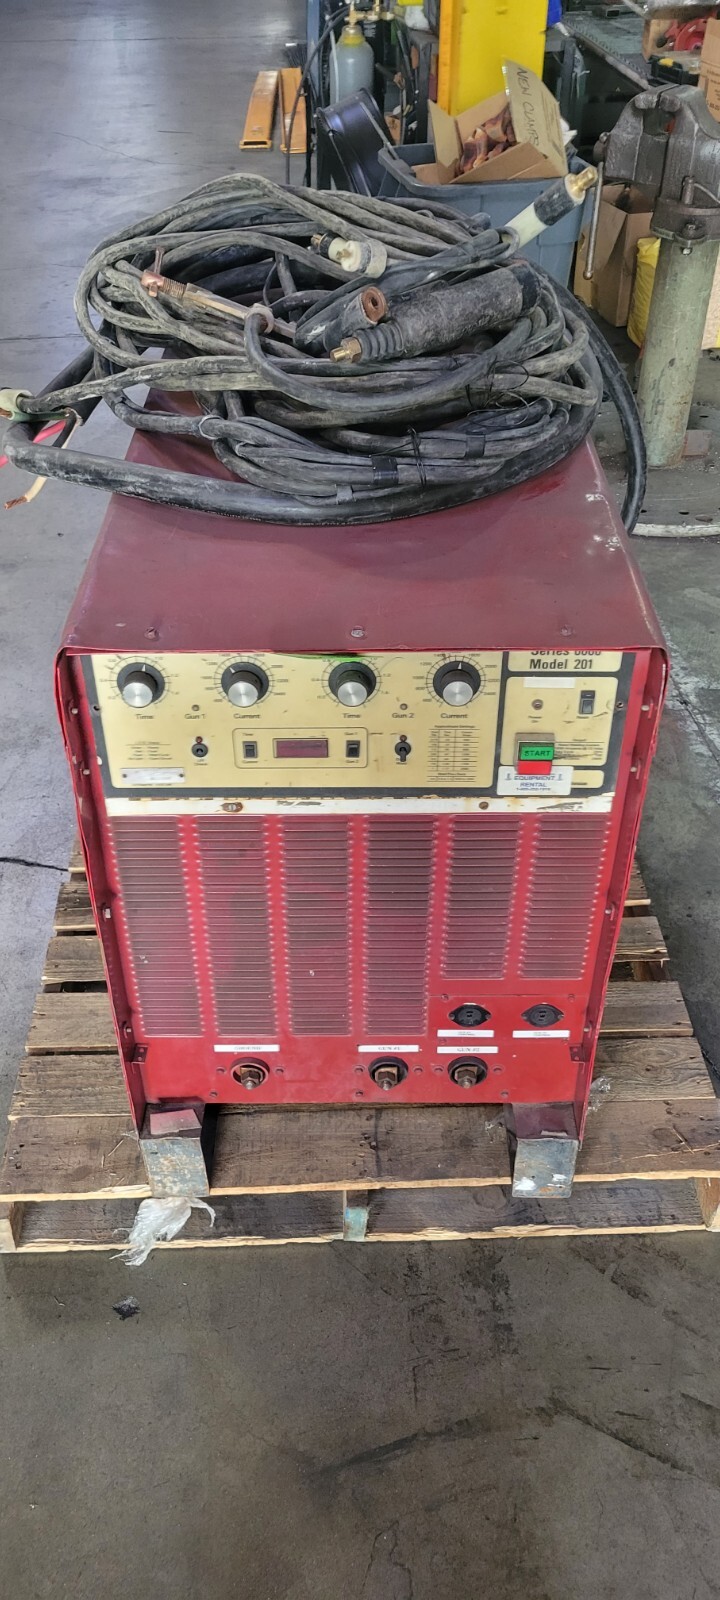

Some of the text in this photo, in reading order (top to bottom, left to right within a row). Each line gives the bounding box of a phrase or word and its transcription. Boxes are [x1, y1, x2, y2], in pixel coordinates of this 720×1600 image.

[529, 658, 594, 670] Model 201
[524, 749, 552, 758] START
